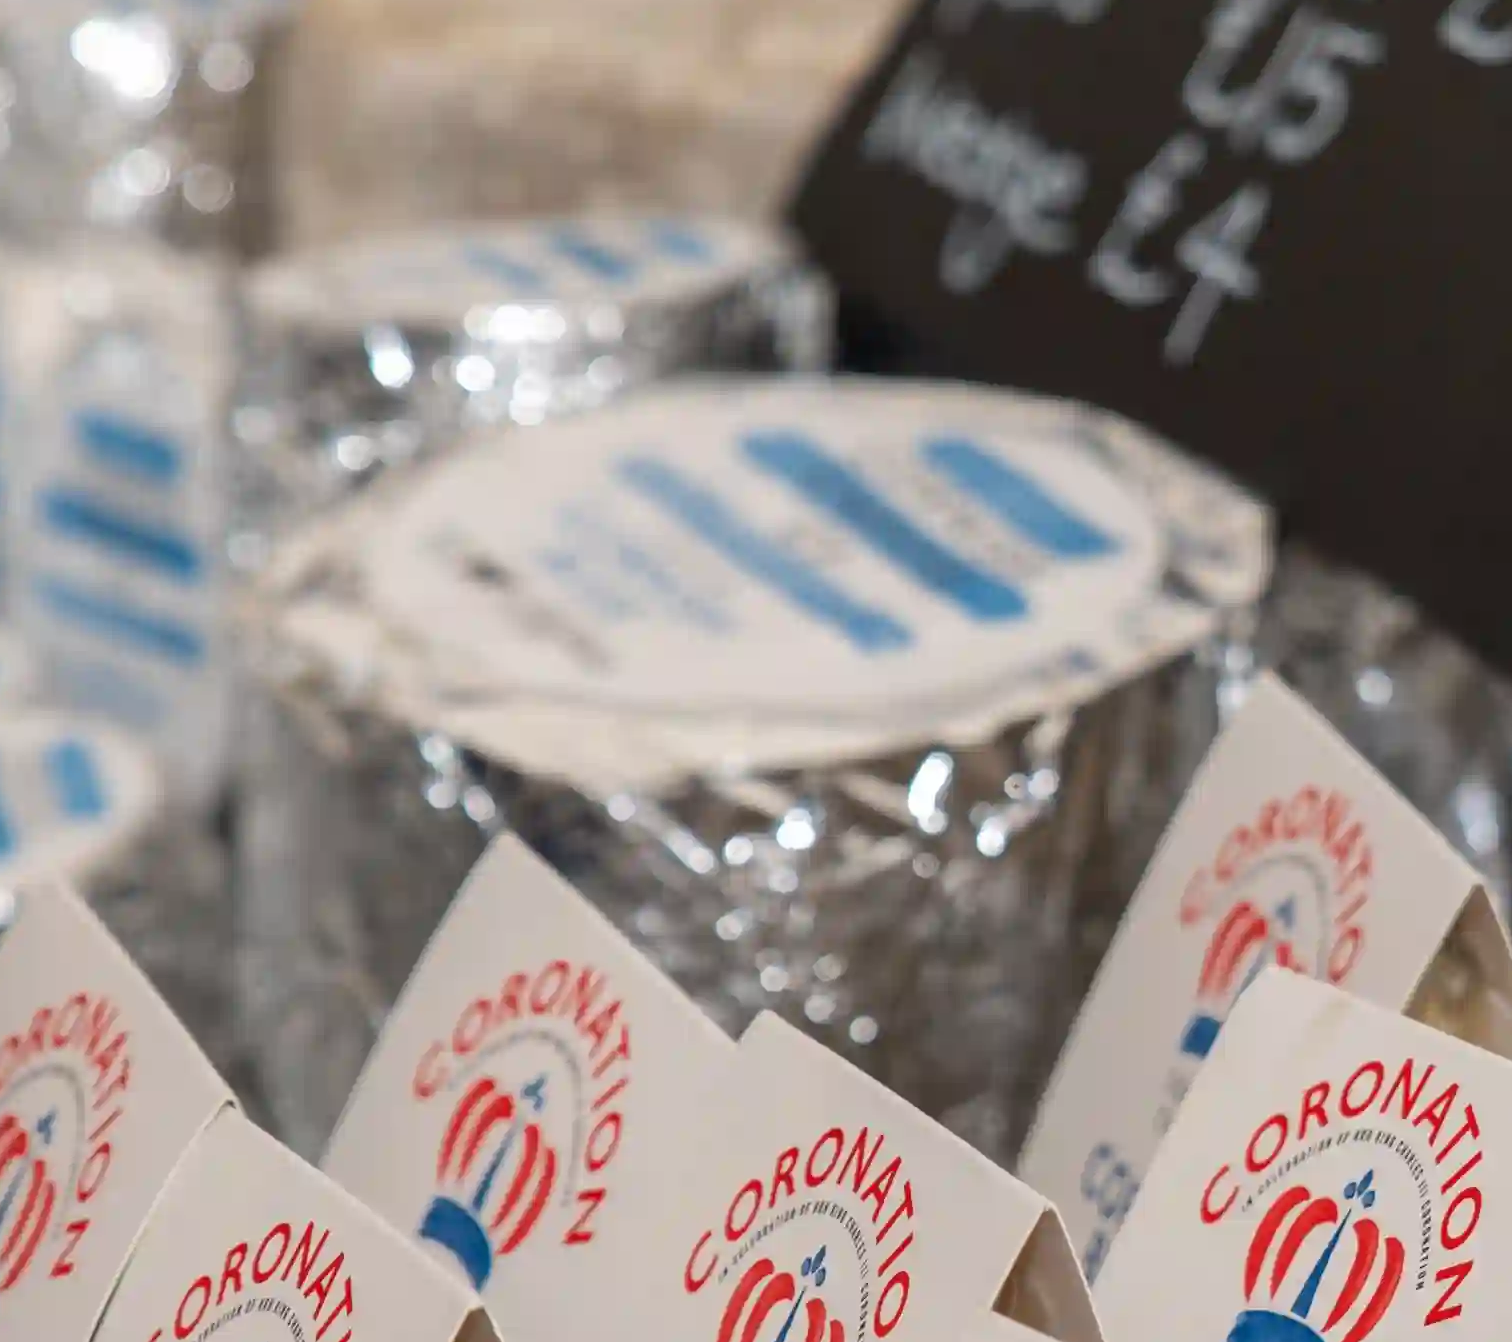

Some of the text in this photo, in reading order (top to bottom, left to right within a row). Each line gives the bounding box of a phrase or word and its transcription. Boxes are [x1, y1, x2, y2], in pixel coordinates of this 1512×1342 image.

[1087, 133, 1268, 365] £4
[413, 960, 631, 1245] CORONATION
[1200, 1058, 1483, 1327] CORONATION
